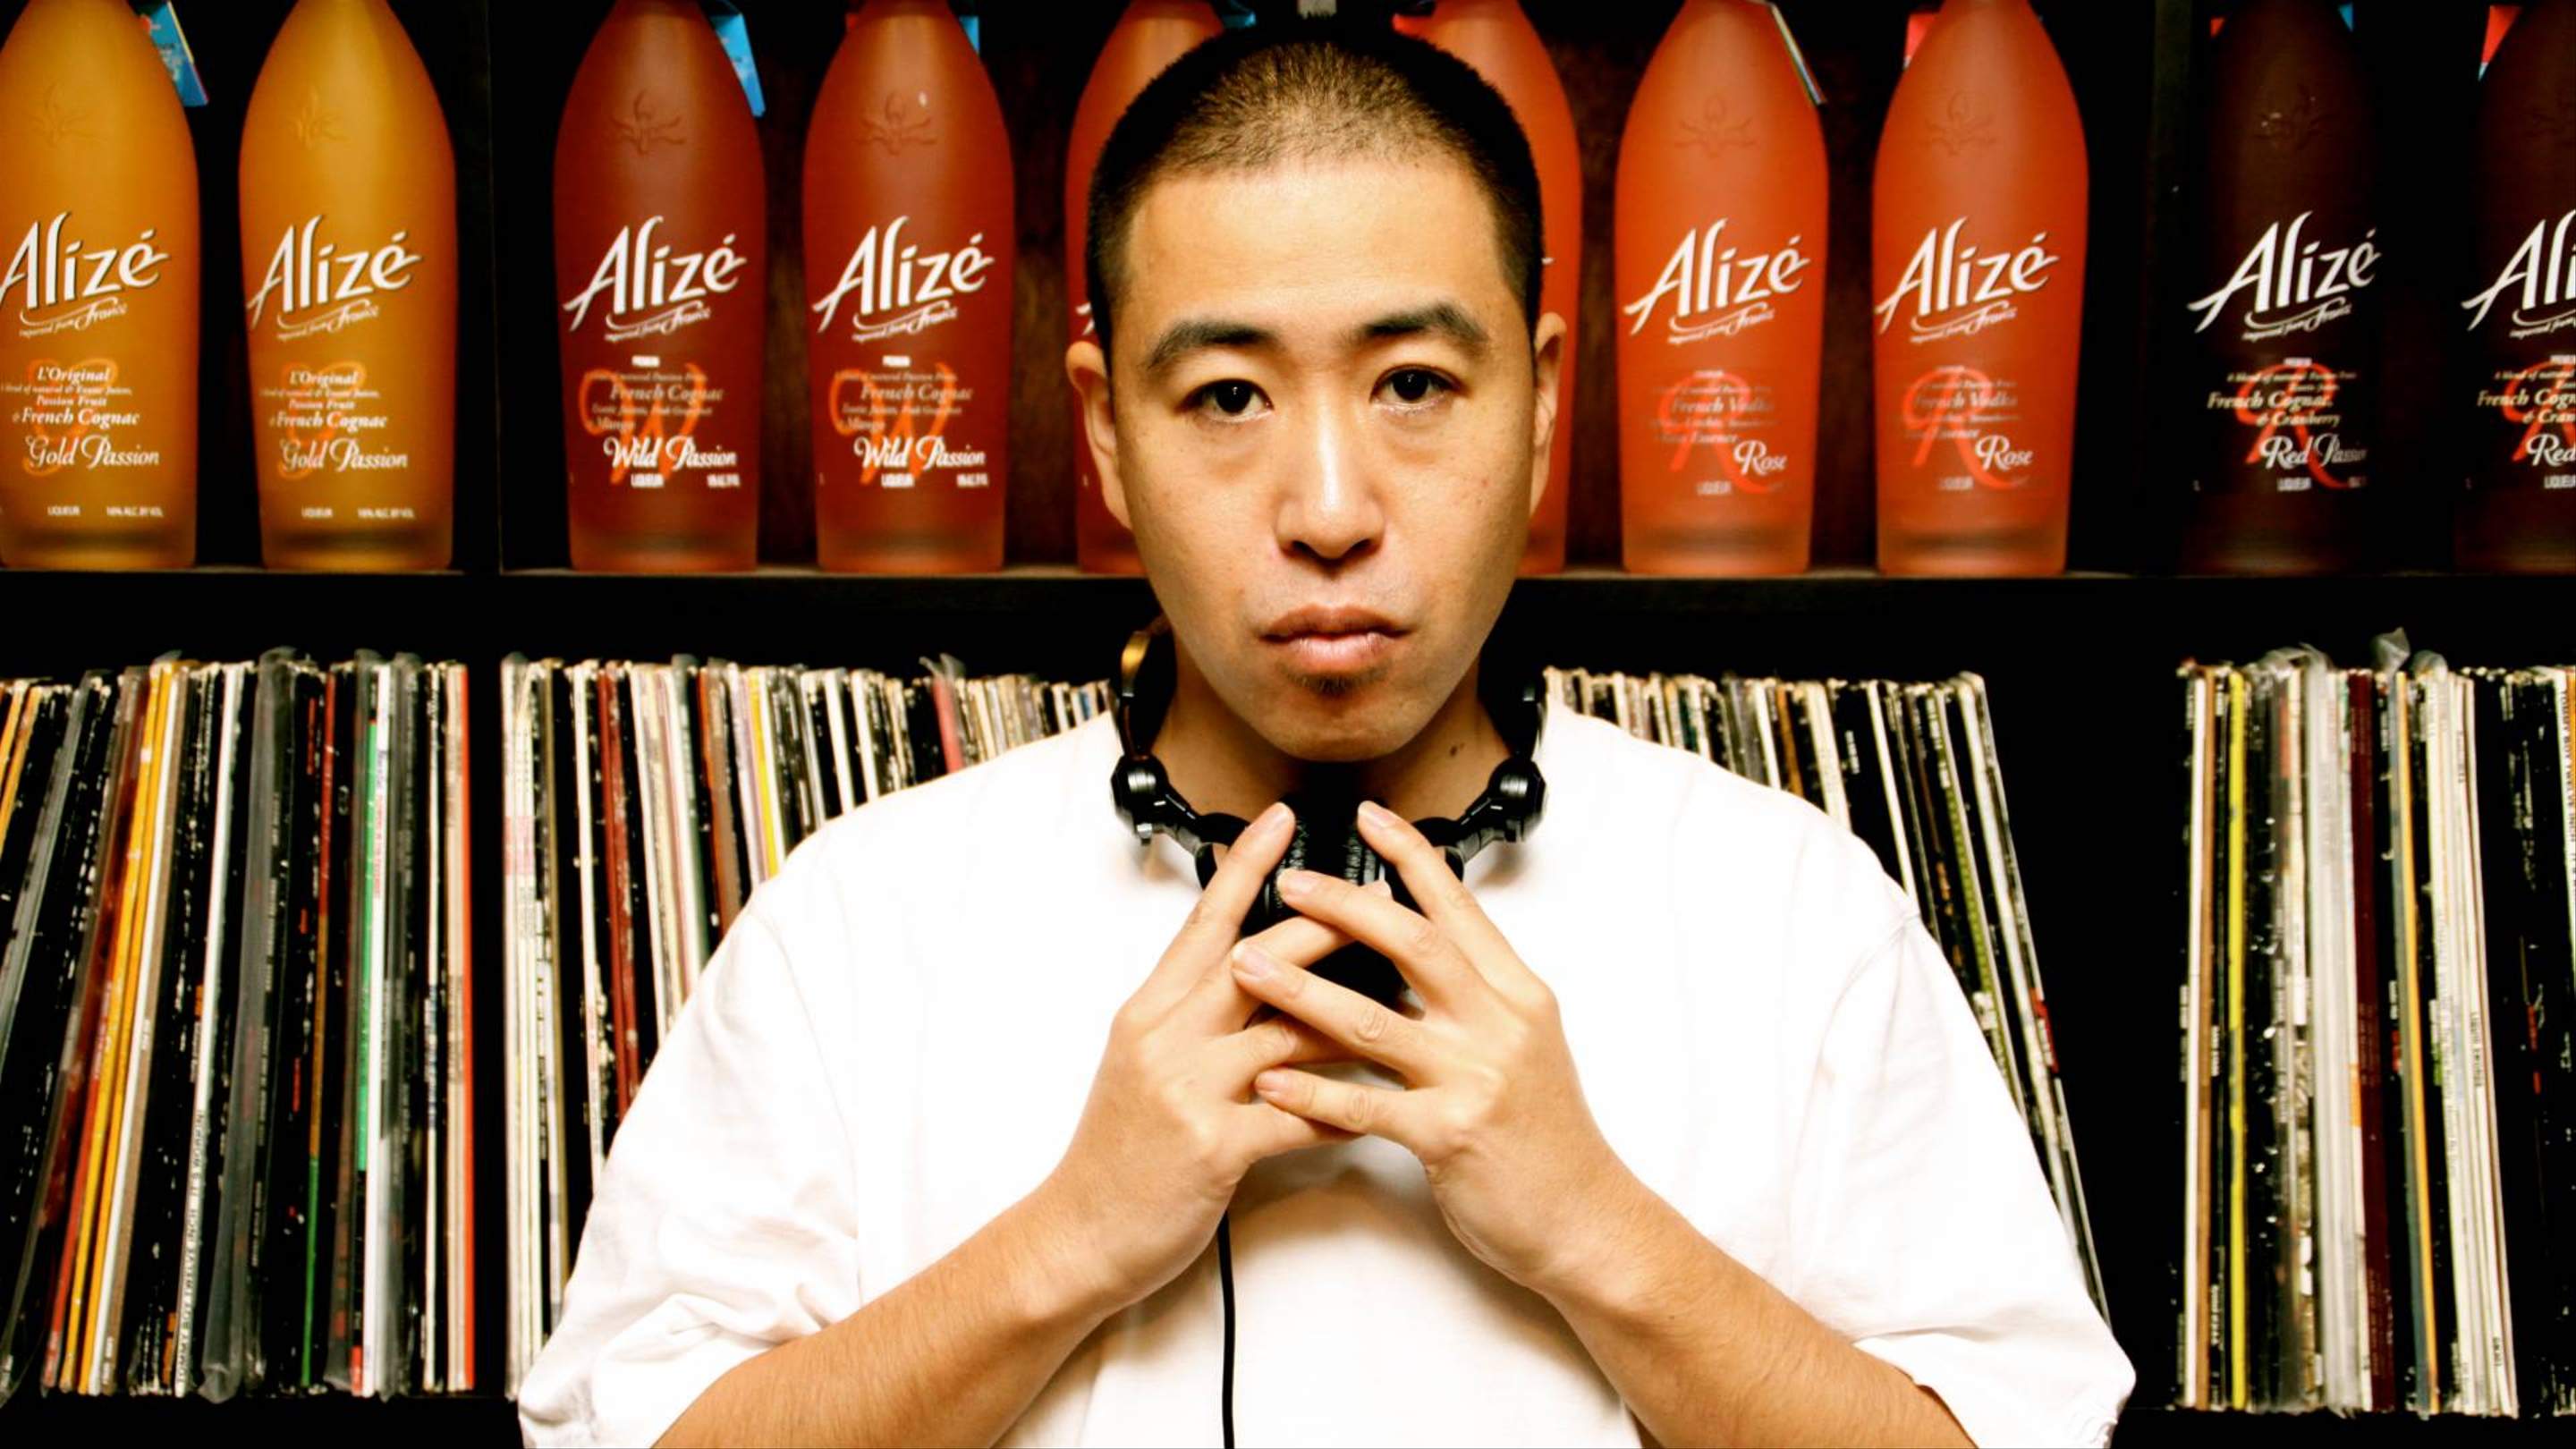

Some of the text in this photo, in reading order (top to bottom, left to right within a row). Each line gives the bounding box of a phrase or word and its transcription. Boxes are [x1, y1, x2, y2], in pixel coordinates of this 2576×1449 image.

[0, 209, 170, 309] Alizé
[246, 215, 422, 329] Alizé
[563, 215, 748, 332] Alizé
[812, 215, 995, 333] Alizé
[1623, 216, 1811, 336] Alizé
[1875, 216, 2060, 335] Alizé
[2187, 210, 2382, 334] Alizé
[38, 367, 111, 386] L'Original
[290, 371, 358, 387] L'Original
[860, 383, 972, 405] French Cognac
[610, 383, 723, 406] French Cognac
[2207, 391, 2264, 409] French
[2477, 388, 2529, 407] French
[21, 407, 74, 424] French
[78, 408, 140, 429] Cognac
[276, 411, 387, 433] French Cognac
[2270, 411, 2341, 428] Cranberry
[25, 434, 159, 469] Gold Passion
[280, 437, 408, 472] Gold Passion
[603, 435, 737, 471] Wild Passion
[853, 436, 986, 470] Wild Passion
[1733, 439, 1787, 476] Rose
[1975, 435, 2033, 472] Rose
[2259, 436, 2314, 470] Red
[183, 1244, 195, 1296] TWELVE
[181, 1303, 191, 1329] BOY
[178, 1334, 190, 1383] TOMMY
